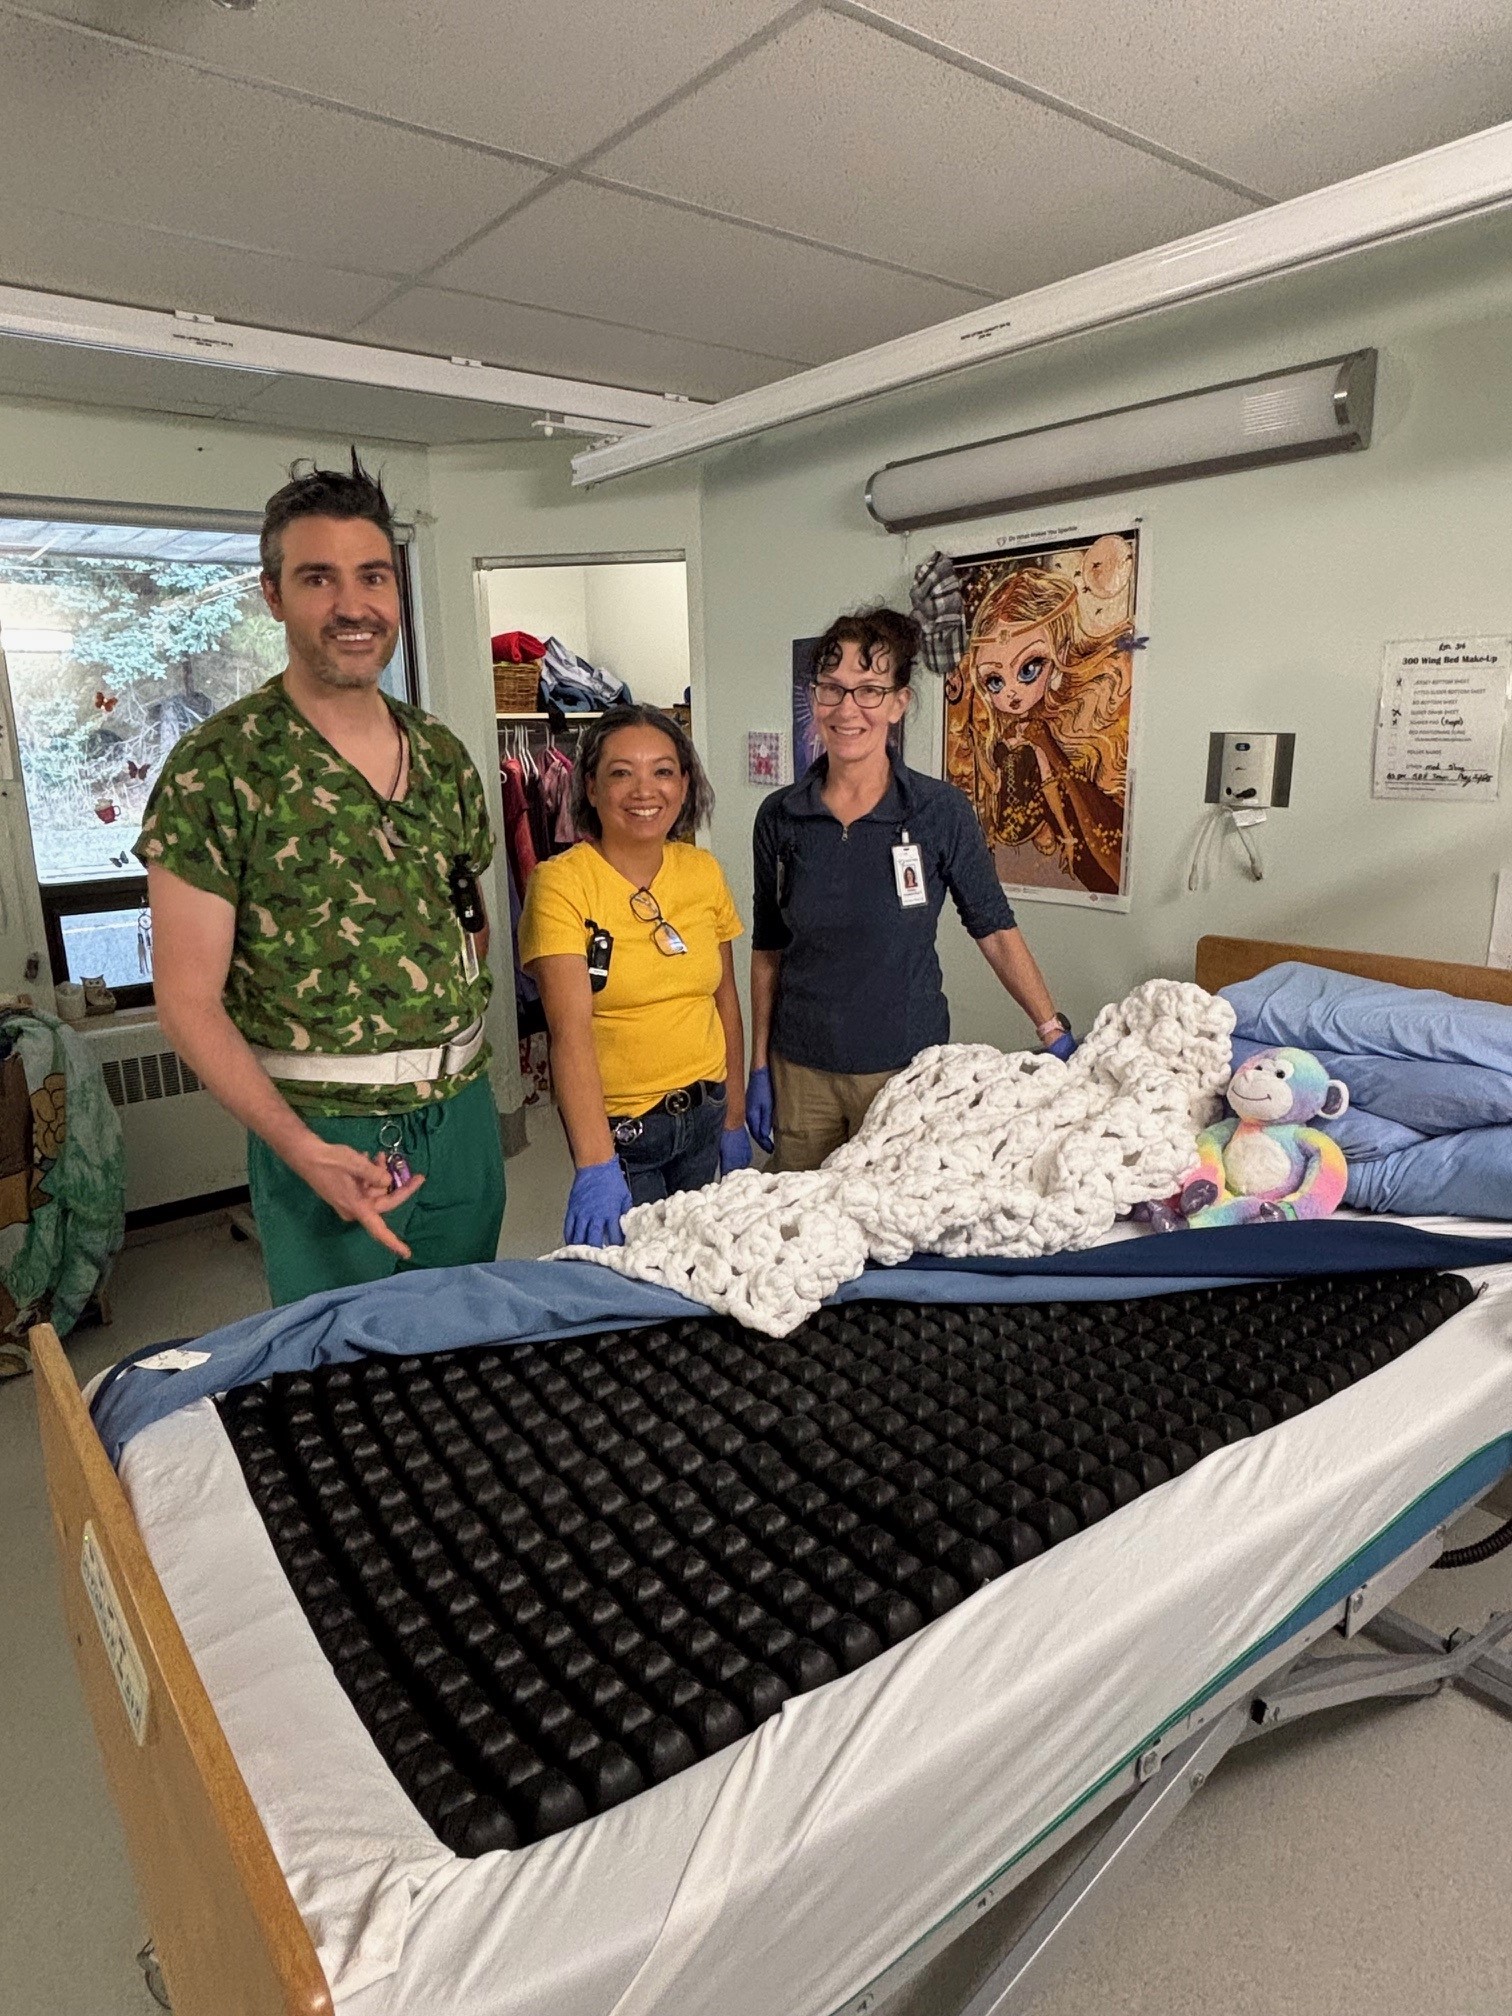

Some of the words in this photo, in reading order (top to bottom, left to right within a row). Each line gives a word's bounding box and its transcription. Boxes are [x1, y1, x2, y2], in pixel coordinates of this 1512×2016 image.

[1403, 657, 1418, 665] 300
[1421, 657, 1441, 666] Wing
[1444, 656, 1460, 664] Bed
[1462, 655, 1497, 663] Make-Up
